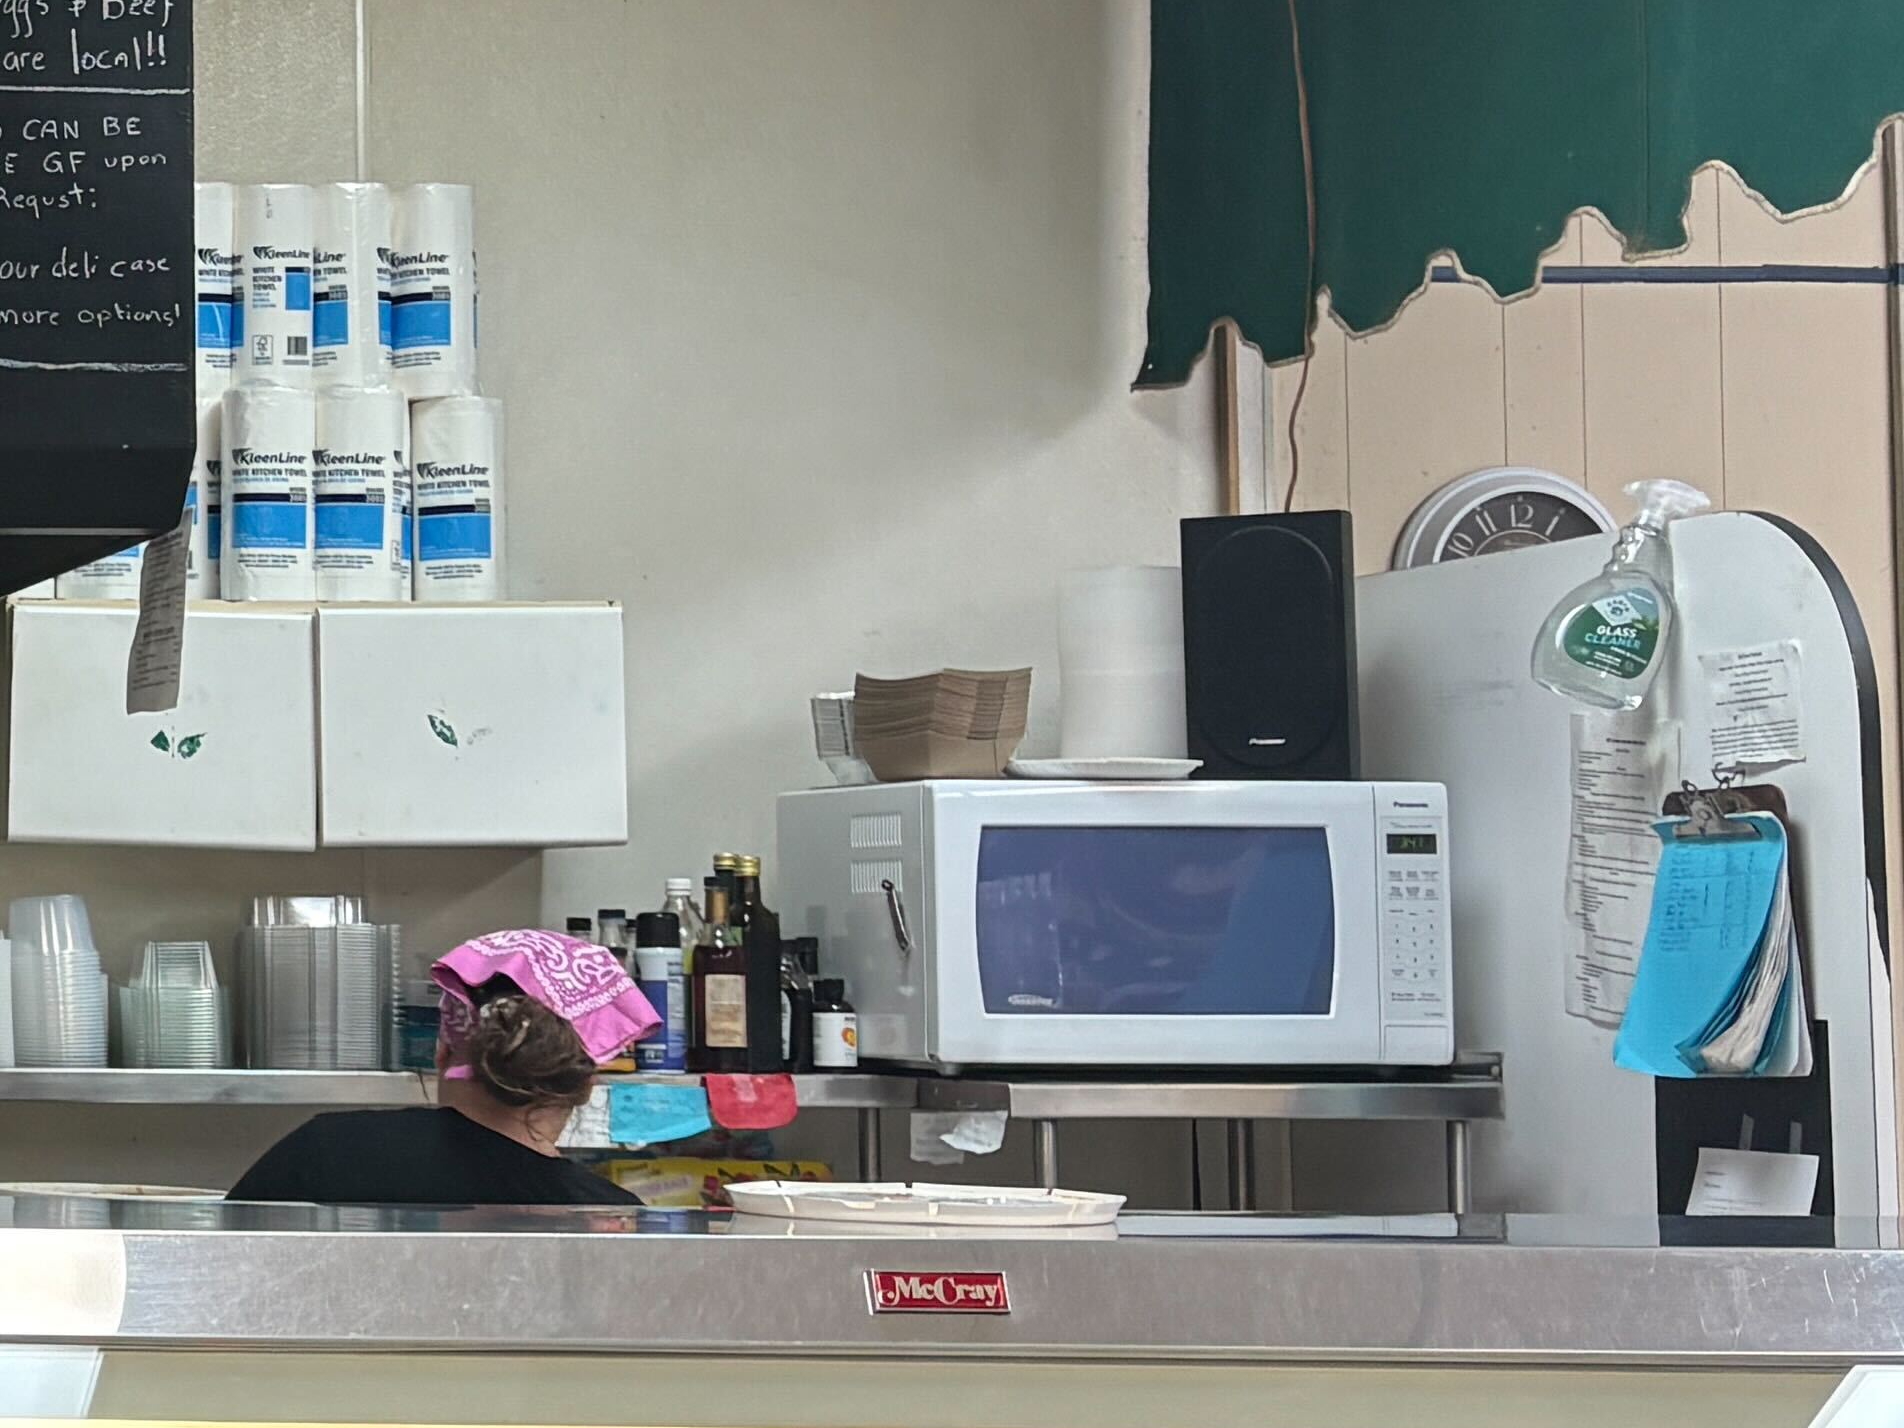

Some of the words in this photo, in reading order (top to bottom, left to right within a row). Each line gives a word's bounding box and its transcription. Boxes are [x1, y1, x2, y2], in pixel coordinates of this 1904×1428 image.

[3, 51, 45, 72] are
[22, 119, 79, 141] CAN
[103, 116, 141, 136] BE
[43, 151, 86, 174] GF
[104, 153, 167, 172] upon
[52, 246, 99, 279] deli
[110, 257, 170, 278] case
[1584, 633, 1641, 649] CLEANER
[1596, 625, 1637, 638] GLASS
[879, 1275, 1000, 1307] McCray
